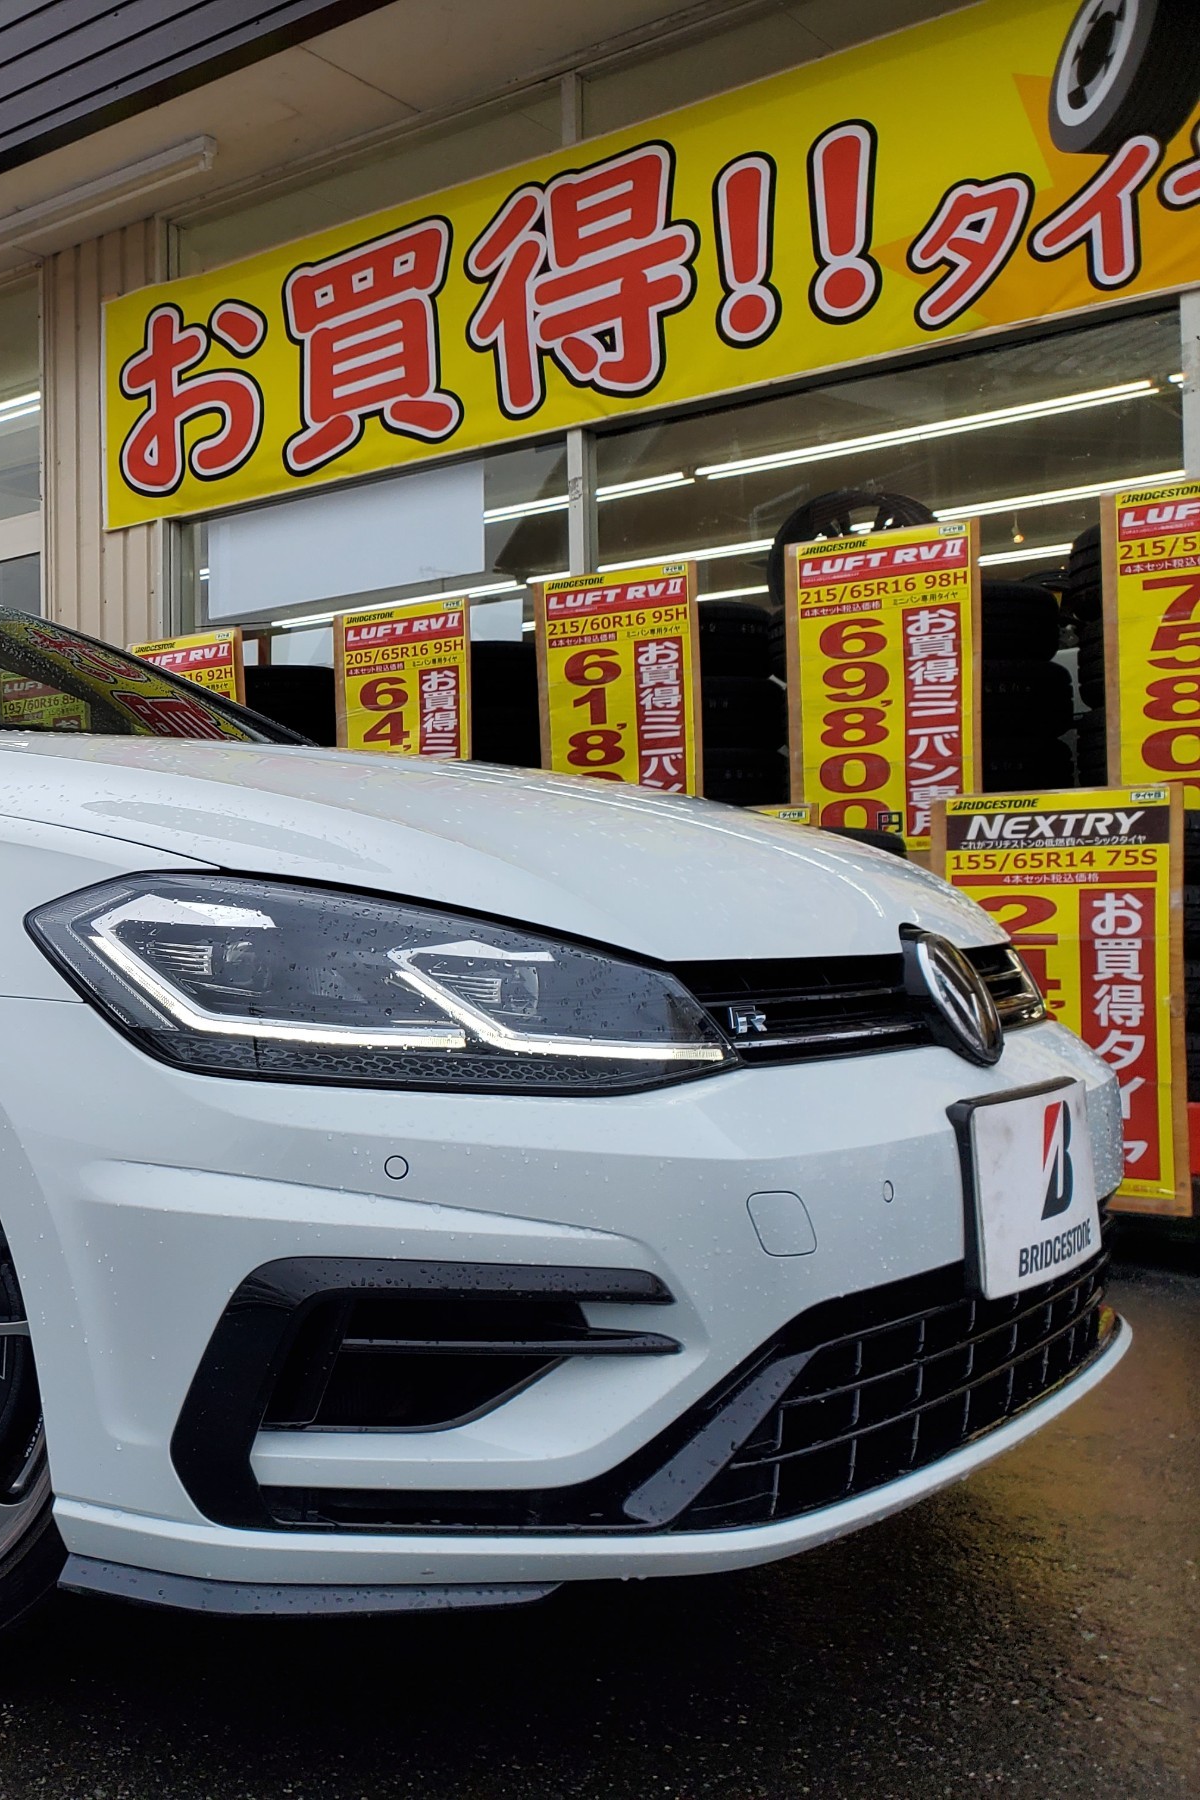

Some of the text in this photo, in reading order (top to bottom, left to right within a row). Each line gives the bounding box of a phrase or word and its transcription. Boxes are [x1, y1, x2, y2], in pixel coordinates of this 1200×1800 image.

[1121, 485, 1200, 504] BRIDGESTON
[1122, 502, 1200, 528] LUF
[801, 539, 868, 556] BRIDGESTONE
[1120, 535, 1200, 561] 215/5
[802, 552, 888, 577] LUFT
[1124, 556, 1200, 574] 4本セット税込
[547, 576, 605, 591] BRIDGESTONE
[801, 577, 916, 606] 215/65R16
[924, 571, 968, 589] 98H
[549, 588, 621, 609] LUFT
[804, 601, 881, 617] 4本セット税込価格
[346, 611, 394, 625] BRIDGESTONE
[548, 606, 687, 636] 215/60R16 95H
[347, 621, 408, 642] LUFT
[551, 632, 616, 648] 4本セット税込価格
[146, 652, 187, 667] UFT
[346, 638, 464, 666] 205/65R16 95H
[207, 667, 233, 681] 92H
[1141, 574, 1200, 788] 7580
[564, 648, 627, 781] 61,8
[952, 798, 1039, 811] BRIDGESTONE
[966, 810, 1145, 840] NEXTRY
[952, 848, 1158, 872] 155/65R14 75S
[1002, 873, 1100, 884] 4本セット税込価格
[729, 1005, 767, 1034] R
[1019, 1218, 1091, 1277] BRIDGESTONE
